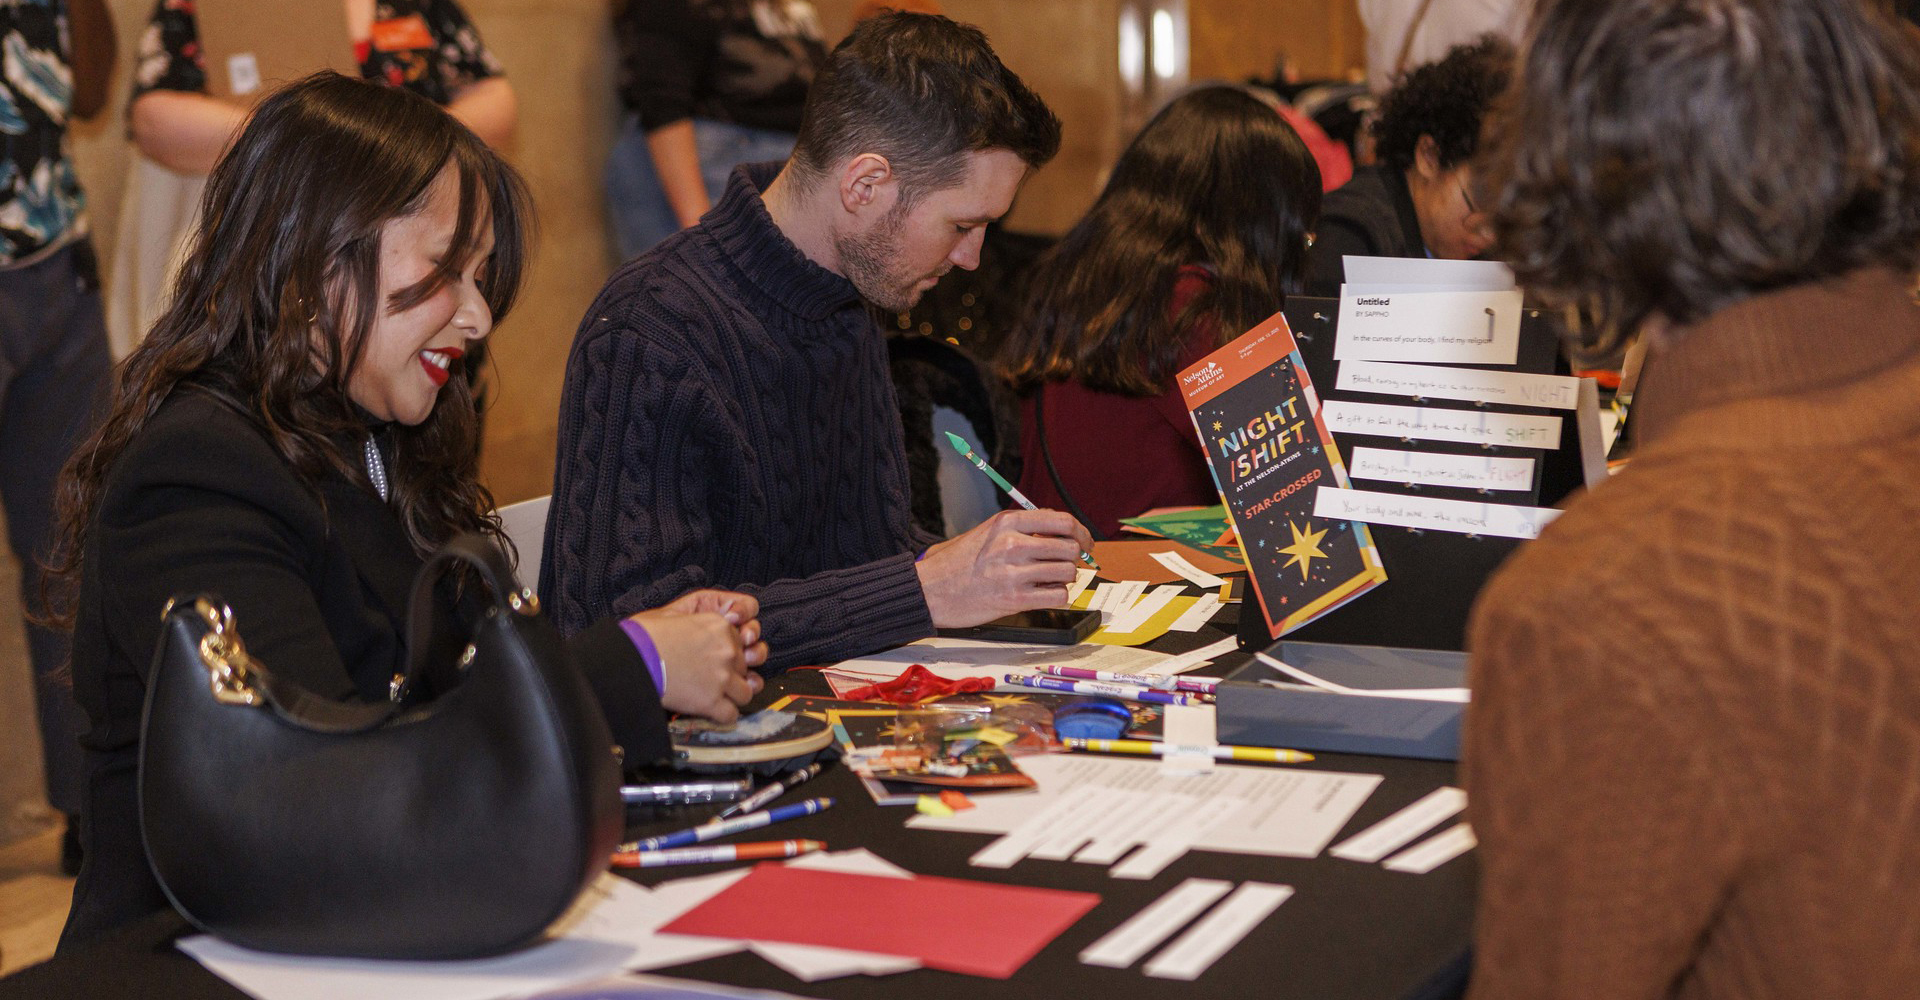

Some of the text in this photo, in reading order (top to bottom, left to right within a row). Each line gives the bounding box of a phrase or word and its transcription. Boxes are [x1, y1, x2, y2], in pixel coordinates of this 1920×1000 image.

[1357, 297, 1390, 306] Untitled
[1355, 310, 1389, 318] BY SAPPHO
[1394, 335, 1401, 343] of
[1401, 337, 1417, 345] your
[1456, 338, 1466, 346] my
[1183, 366, 1210, 386] Nelson
[1188, 373, 1225, 397] MUSEUM OF ART
[1197, 366, 1224, 386] Atkins
[1520, 384, 1571, 404] NIGHT
[1218, 396, 1297, 458] NIGHT
[1336, 412, 1344, 421] A
[1505, 428, 1549, 443] SHIFT
[1230, 420, 1306, 483] /SHIFT
[1236, 451, 1302, 493] AT THE NELSON-ATKINS
[1245, 468, 1322, 520] STAR-CROSSED
[1365, 503, 1386, 517] body
